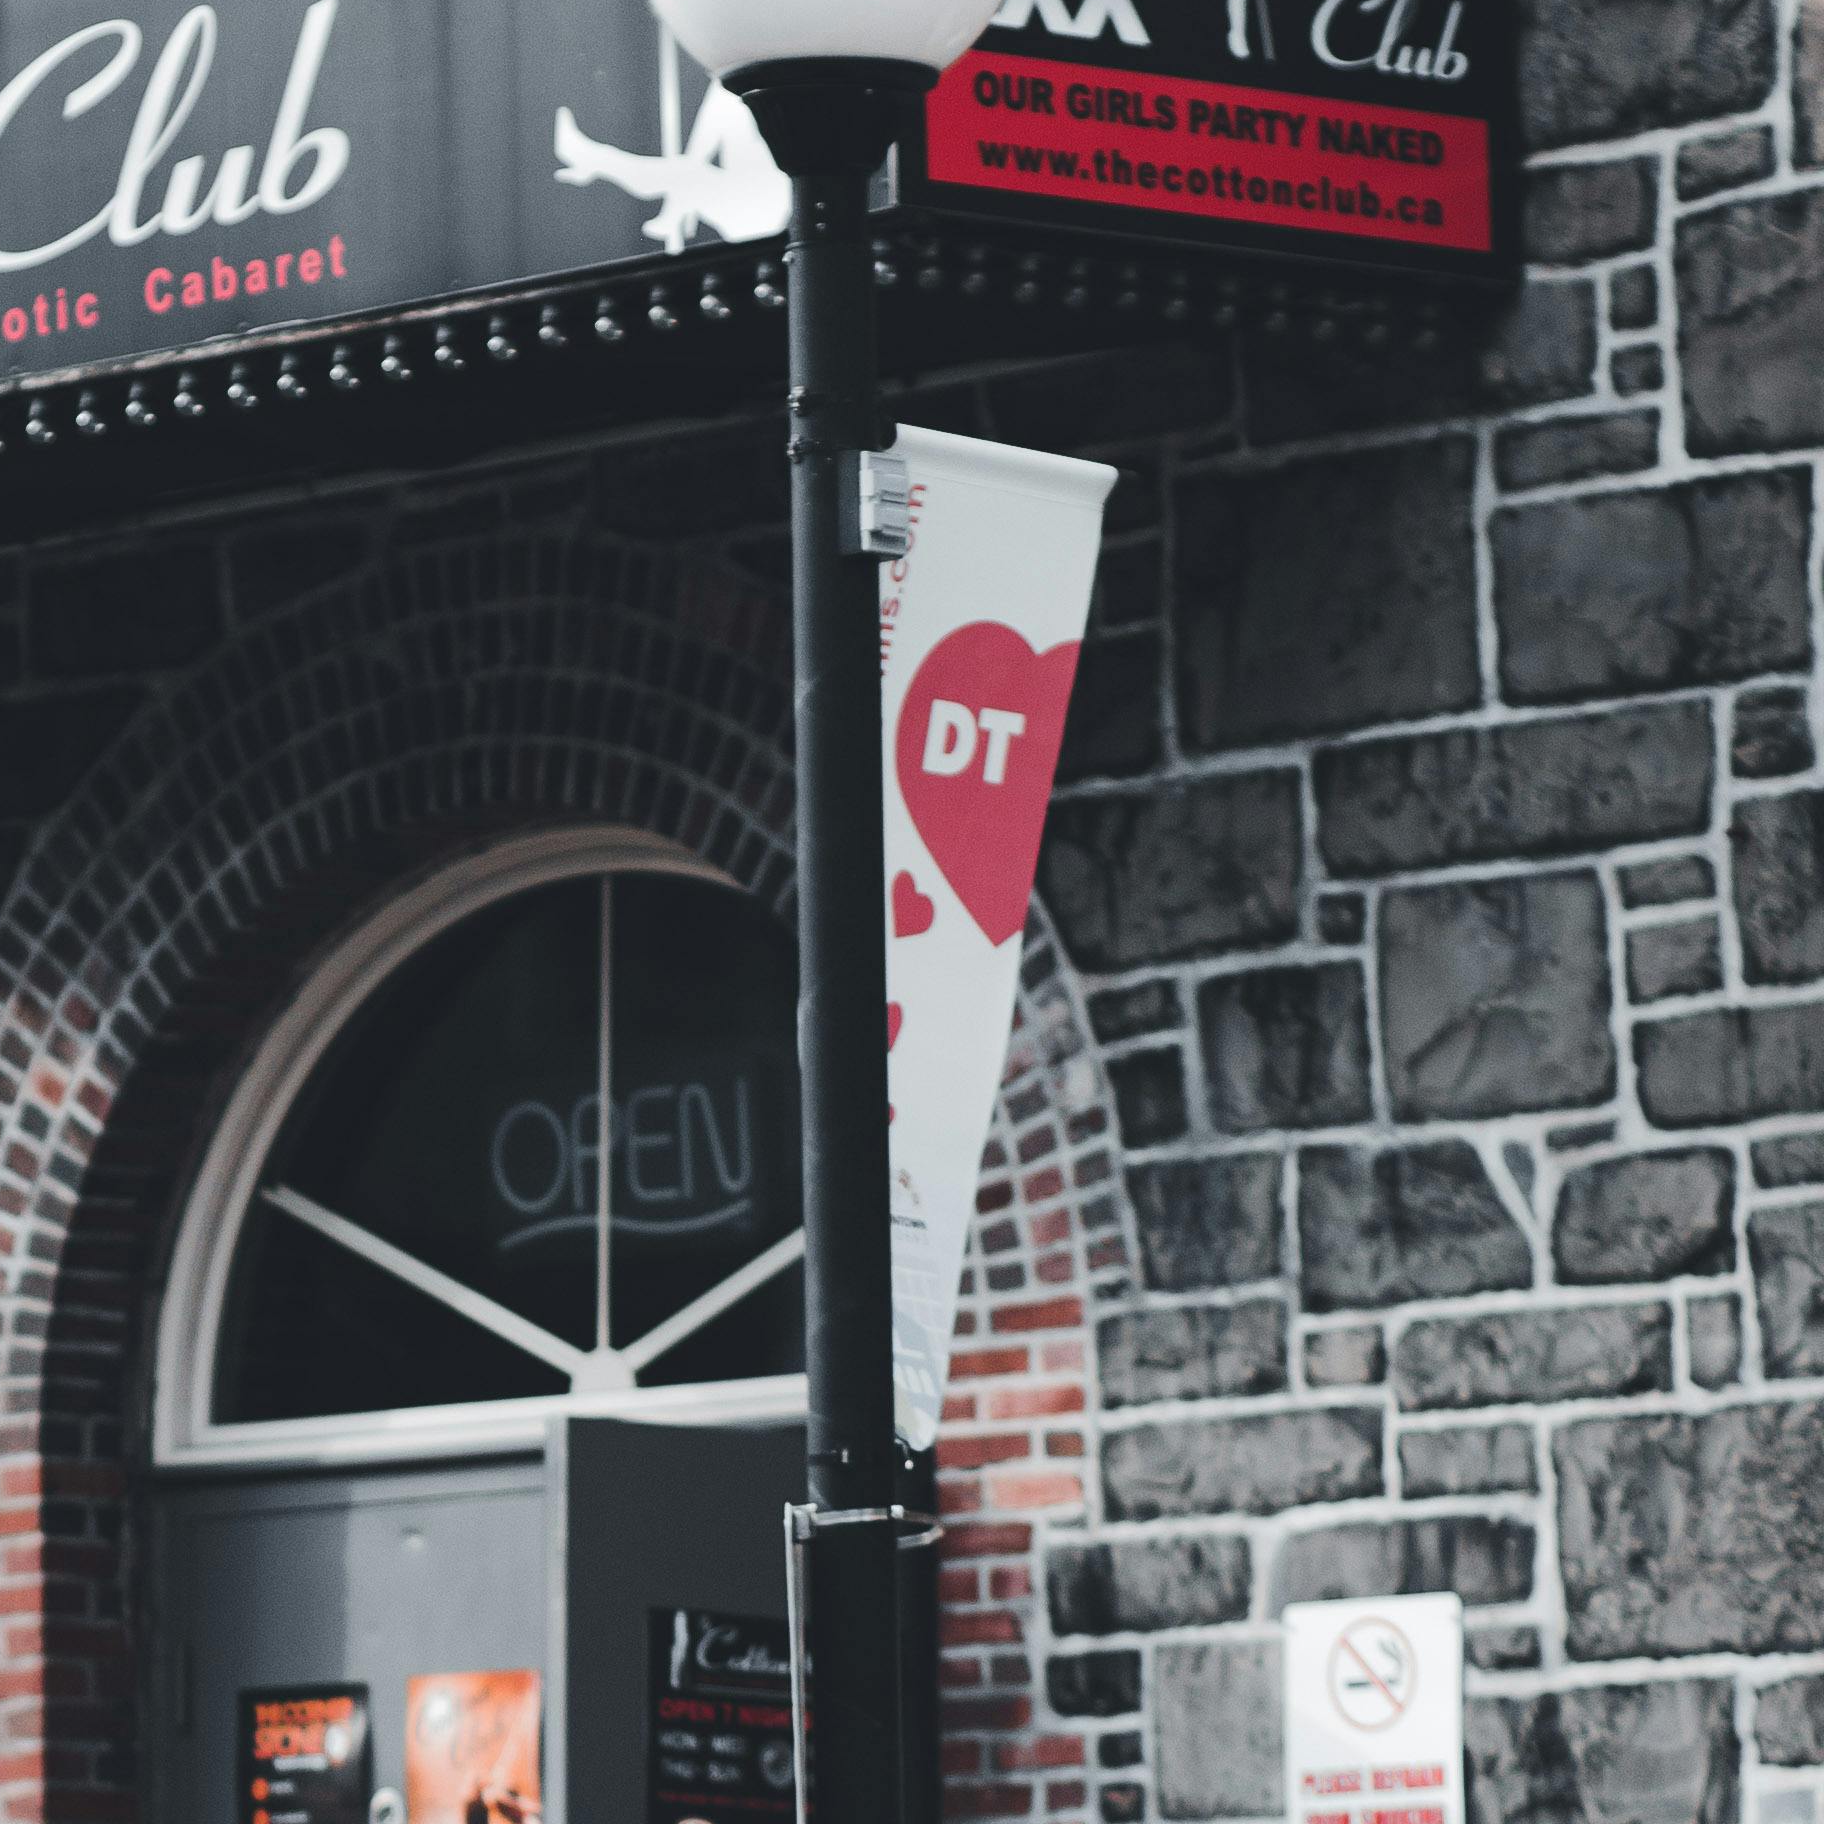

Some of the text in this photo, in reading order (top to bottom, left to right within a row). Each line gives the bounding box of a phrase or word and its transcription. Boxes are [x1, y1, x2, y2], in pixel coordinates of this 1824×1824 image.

[974, 69, 1446, 167] OUR GIRLS PARTY NAKED
[977, 139, 1445, 228] www.thecottonclub.ca
[143, 235, 346, 314] Cabaret
[922, 698, 1025, 785] DT
[491, 1078, 752, 1213] OPEN
